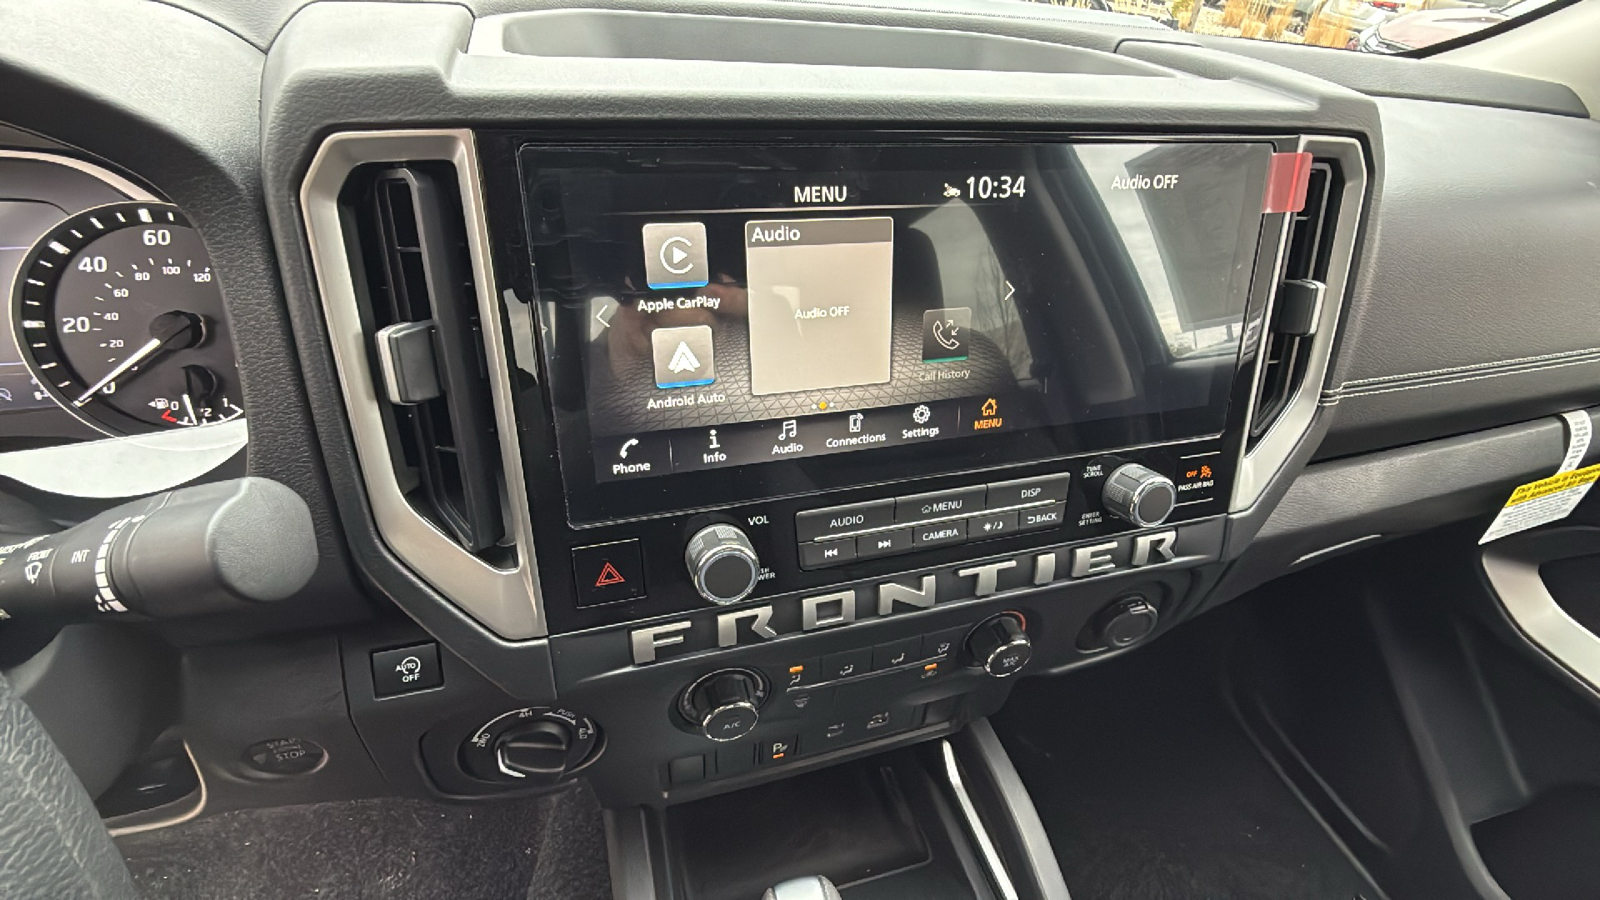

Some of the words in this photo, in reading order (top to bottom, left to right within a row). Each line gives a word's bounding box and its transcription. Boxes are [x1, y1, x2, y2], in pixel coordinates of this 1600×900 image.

[965, 175, 1026, 200] 10:34
[1111, 175, 1152, 190] Audio
[1153, 174, 1179, 189] OFF
[793, 185, 848, 203] MENU
[142, 229, 171, 246] 60
[751, 225, 801, 243] Audio
[78, 256, 108, 273] 40
[162, 265, 181, 275] 100
[134, 272, 150, 281] 80
[193, 272, 211, 282] 120
[113, 288, 129, 298] 60
[638, 297, 674, 313] Apple
[677, 296, 721, 311] CarPlay
[103, 312, 119, 321] 40
[794, 307, 828, 320] Audio
[829, 306, 850, 319] OFF
[62, 316, 90, 333] 20
[109, 339, 124, 348] 20
[918, 370, 936, 382] Call
[938, 367, 971, 382] History
[170, 401, 179, 410] 0
[647, 395, 695, 410] Android
[697, 393, 726, 405] Auto
[974, 418, 1003, 430] MENU
[902, 425, 940, 440] Settings
[826, 432, 887, 449] Connections
[772, 442, 804, 455] Audio
[703, 451, 727, 464] Info
[612, 461, 651, 475] Phone
[1086, 465, 1102, 473] TUNE
[1186, 470, 1198, 478] OFF
[1083, 470, 1104, 479] SCROLL
[1021, 487, 1041, 499] DISP
[931, 500, 963, 512] MENU
[748, 515, 770, 526] VOL
[829, 515, 865, 528] AUDIO
[1036, 511, 1058, 523] BACK
[1078, 517, 1103, 526] SETTING
[1081, 512, 1100, 520] ENTER
[922, 528, 959, 542] CAMERA
[71, 549, 91, 564] INT
[757, 572, 776, 581] WER
[631, 531, 1177, 664] FRONTIER
[395, 662, 416, 672] AUTO
[402, 673, 420, 683] OFF
[518, 710, 533, 718] 4H
[557, 708, 576, 719] PUSH
[723, 720, 742, 731] A/C
[476, 733, 491, 748] 2WD
[275, 749, 306, 762] STOP
